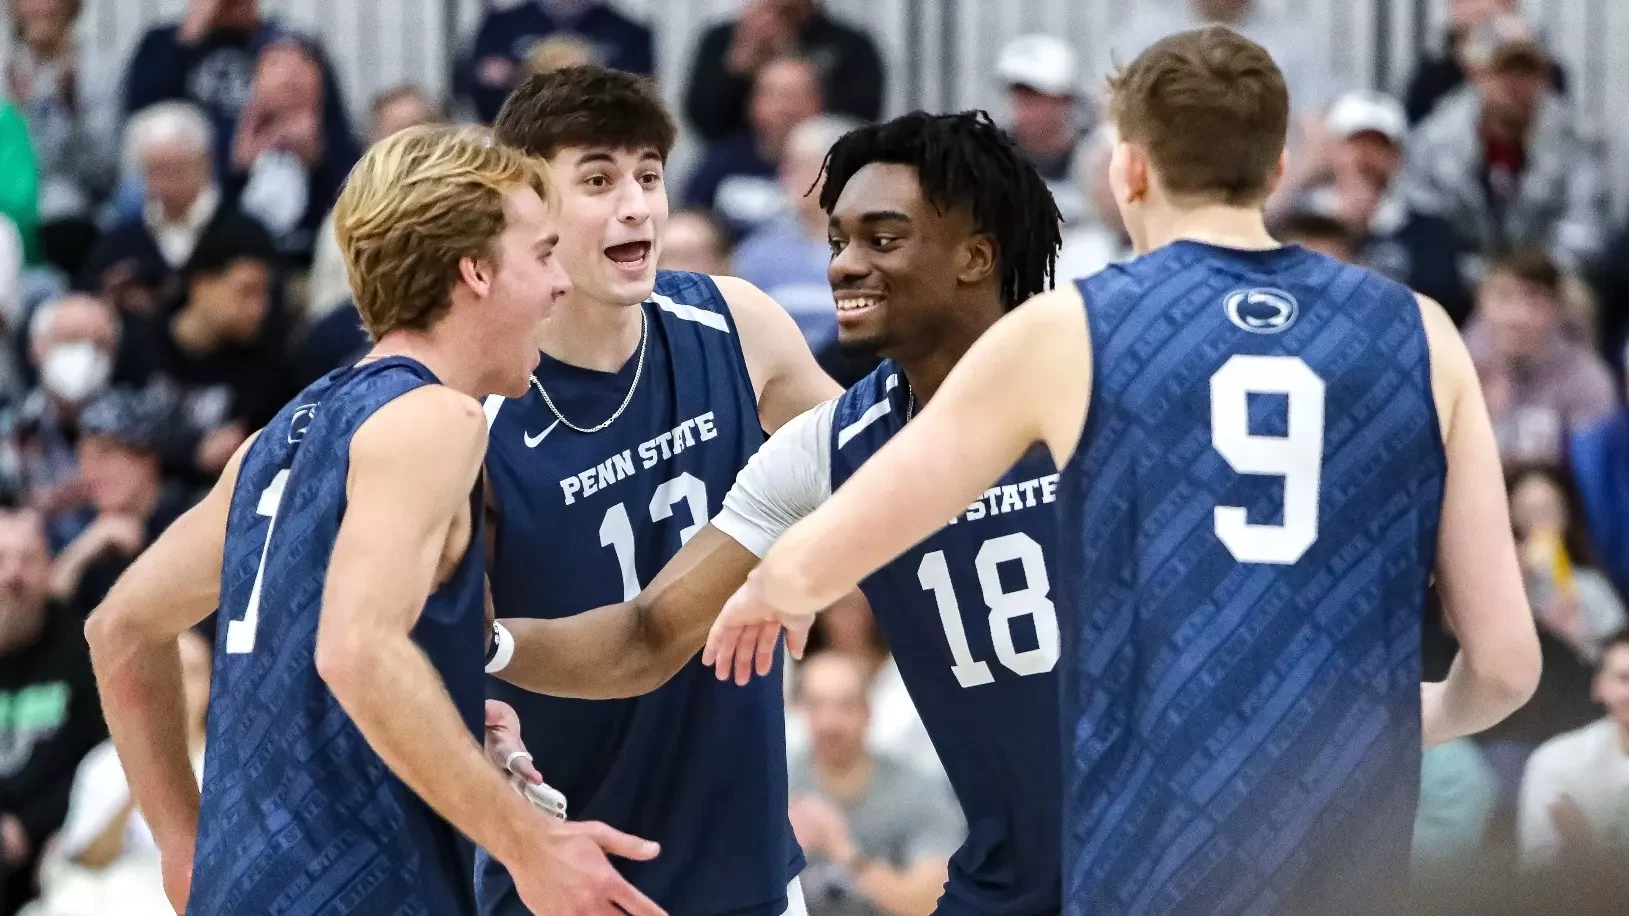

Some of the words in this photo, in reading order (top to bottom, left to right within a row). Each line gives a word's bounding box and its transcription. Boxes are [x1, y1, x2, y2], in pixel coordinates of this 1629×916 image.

[560, 449, 636, 505] PENN
[638, 411, 718, 470] STATE
[1210, 355, 1325, 565] 9
[917, 532, 1061, 688] 18
